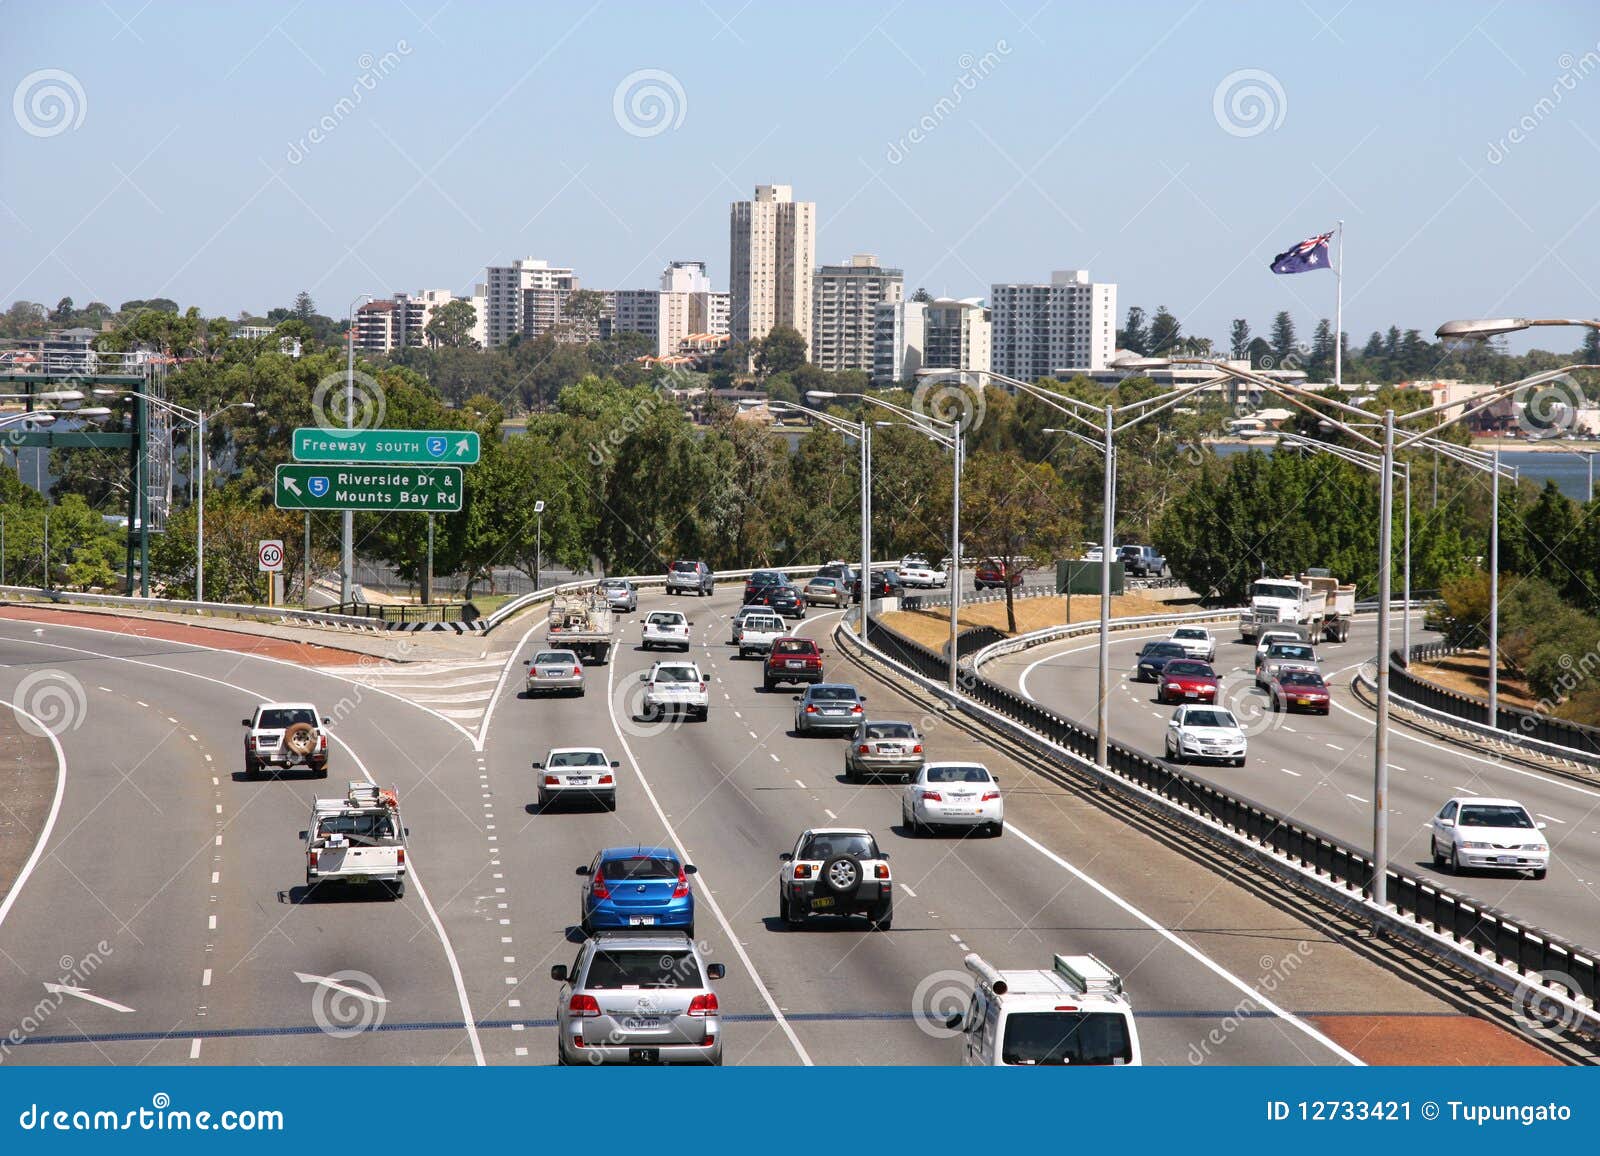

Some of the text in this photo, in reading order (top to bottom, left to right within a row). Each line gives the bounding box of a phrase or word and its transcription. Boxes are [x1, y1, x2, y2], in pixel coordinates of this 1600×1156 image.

[303, 439, 442, 454] Freeway SOUTH 2
[313, 480, 324, 492] 5
[338, 473, 453, 486] Riverside Dr &
[335, 491, 456, 505] Mounts Bay Rd
[264, 550, 279, 561] 60
